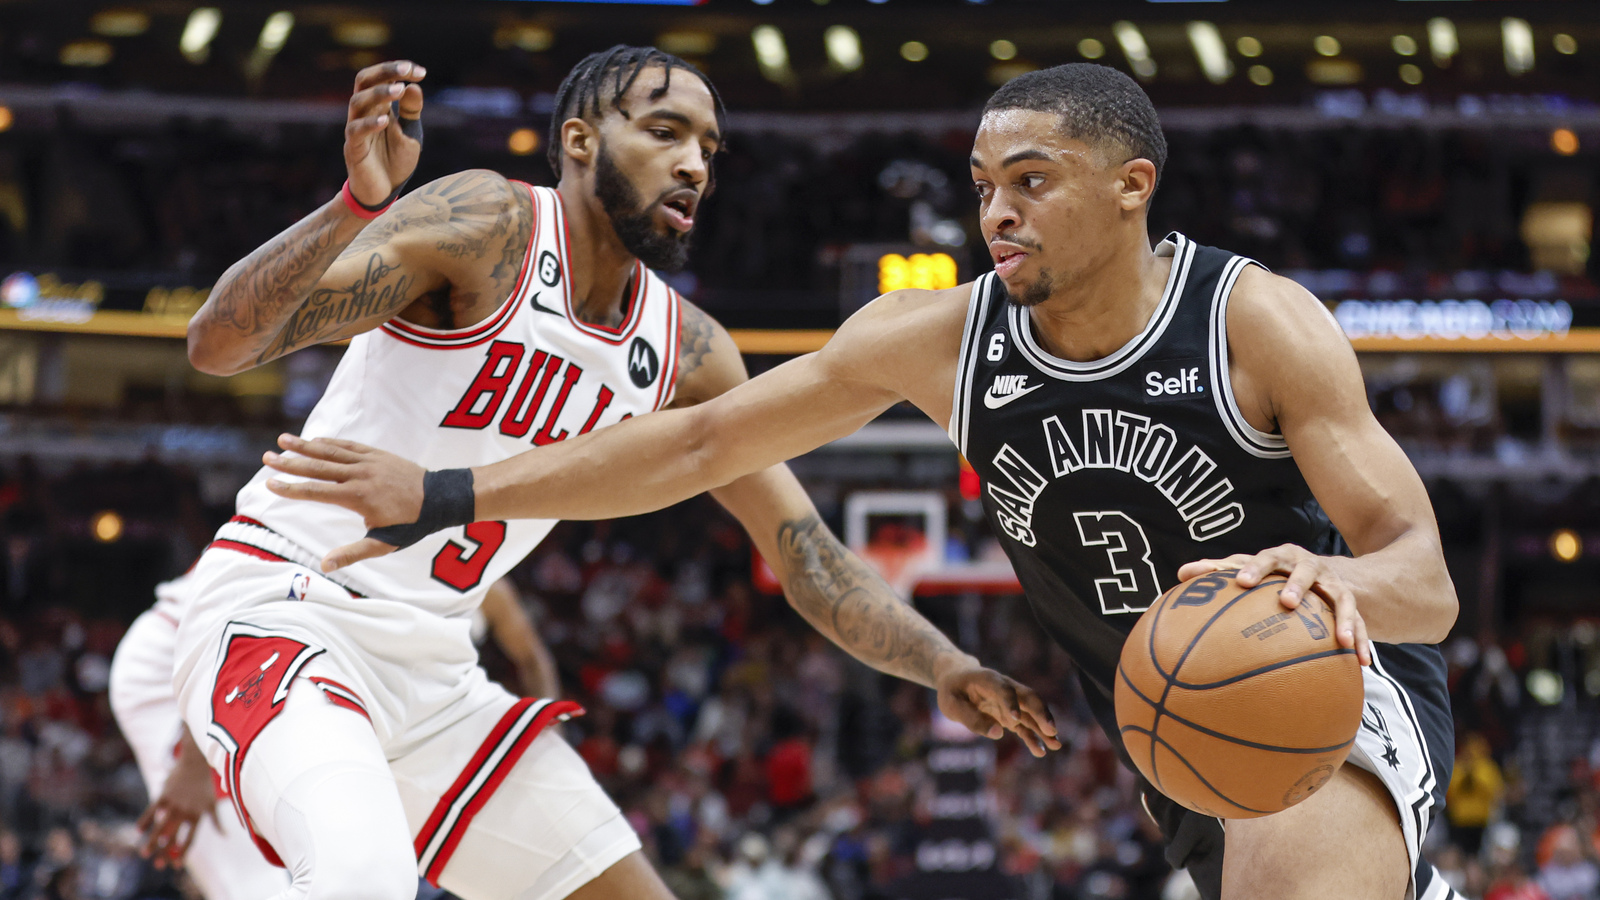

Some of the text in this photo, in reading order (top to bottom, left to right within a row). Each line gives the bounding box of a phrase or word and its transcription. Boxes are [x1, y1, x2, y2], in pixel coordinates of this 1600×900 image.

[540, 252, 558, 285] 6
[986, 332, 1005, 362] 6
[438, 339, 633, 448] BULL
[991, 374, 1029, 395] NIKE
[1145, 367, 1204, 396] Self.
[987, 408, 1246, 548] SAN ANTONIO
[1072, 510, 1163, 615] 3
